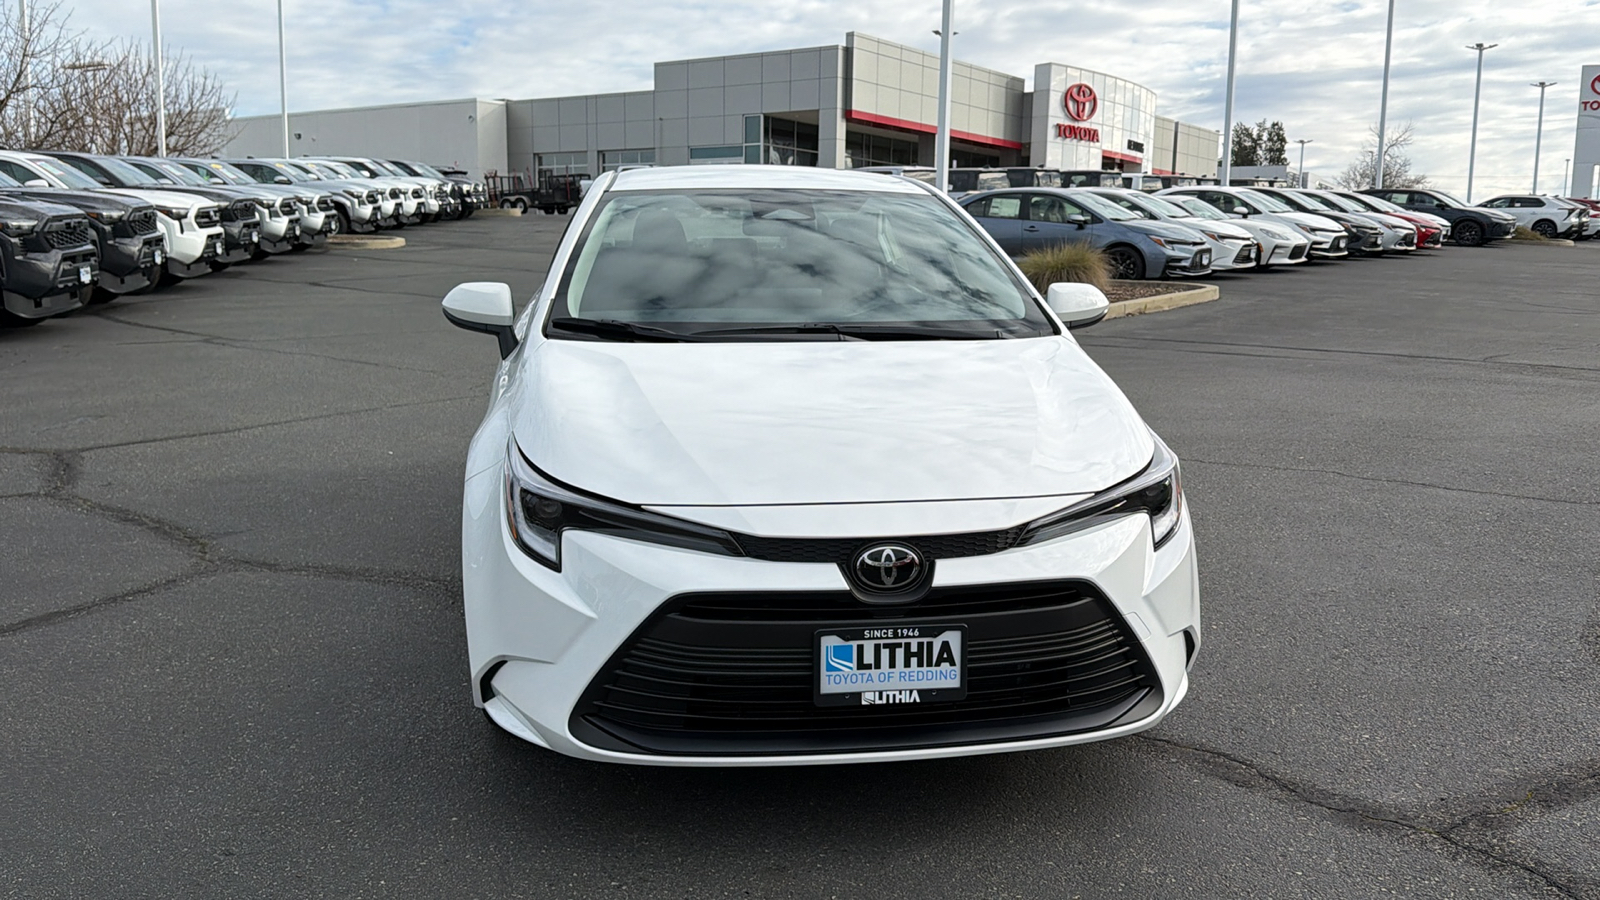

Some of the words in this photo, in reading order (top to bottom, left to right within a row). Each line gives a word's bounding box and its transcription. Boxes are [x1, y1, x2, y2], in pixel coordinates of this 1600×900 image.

[1056, 123, 1100, 143] TOYOTA
[864, 629, 894, 638] SINCE
[897, 628, 920, 637] 1946
[856, 640, 957, 671] LITHIA
[825, 672, 874, 685] TOYOTA
[877, 671, 894, 683] OF
[899, 669, 957, 682] REDDING
[874, 689, 920, 704] LITHIA
